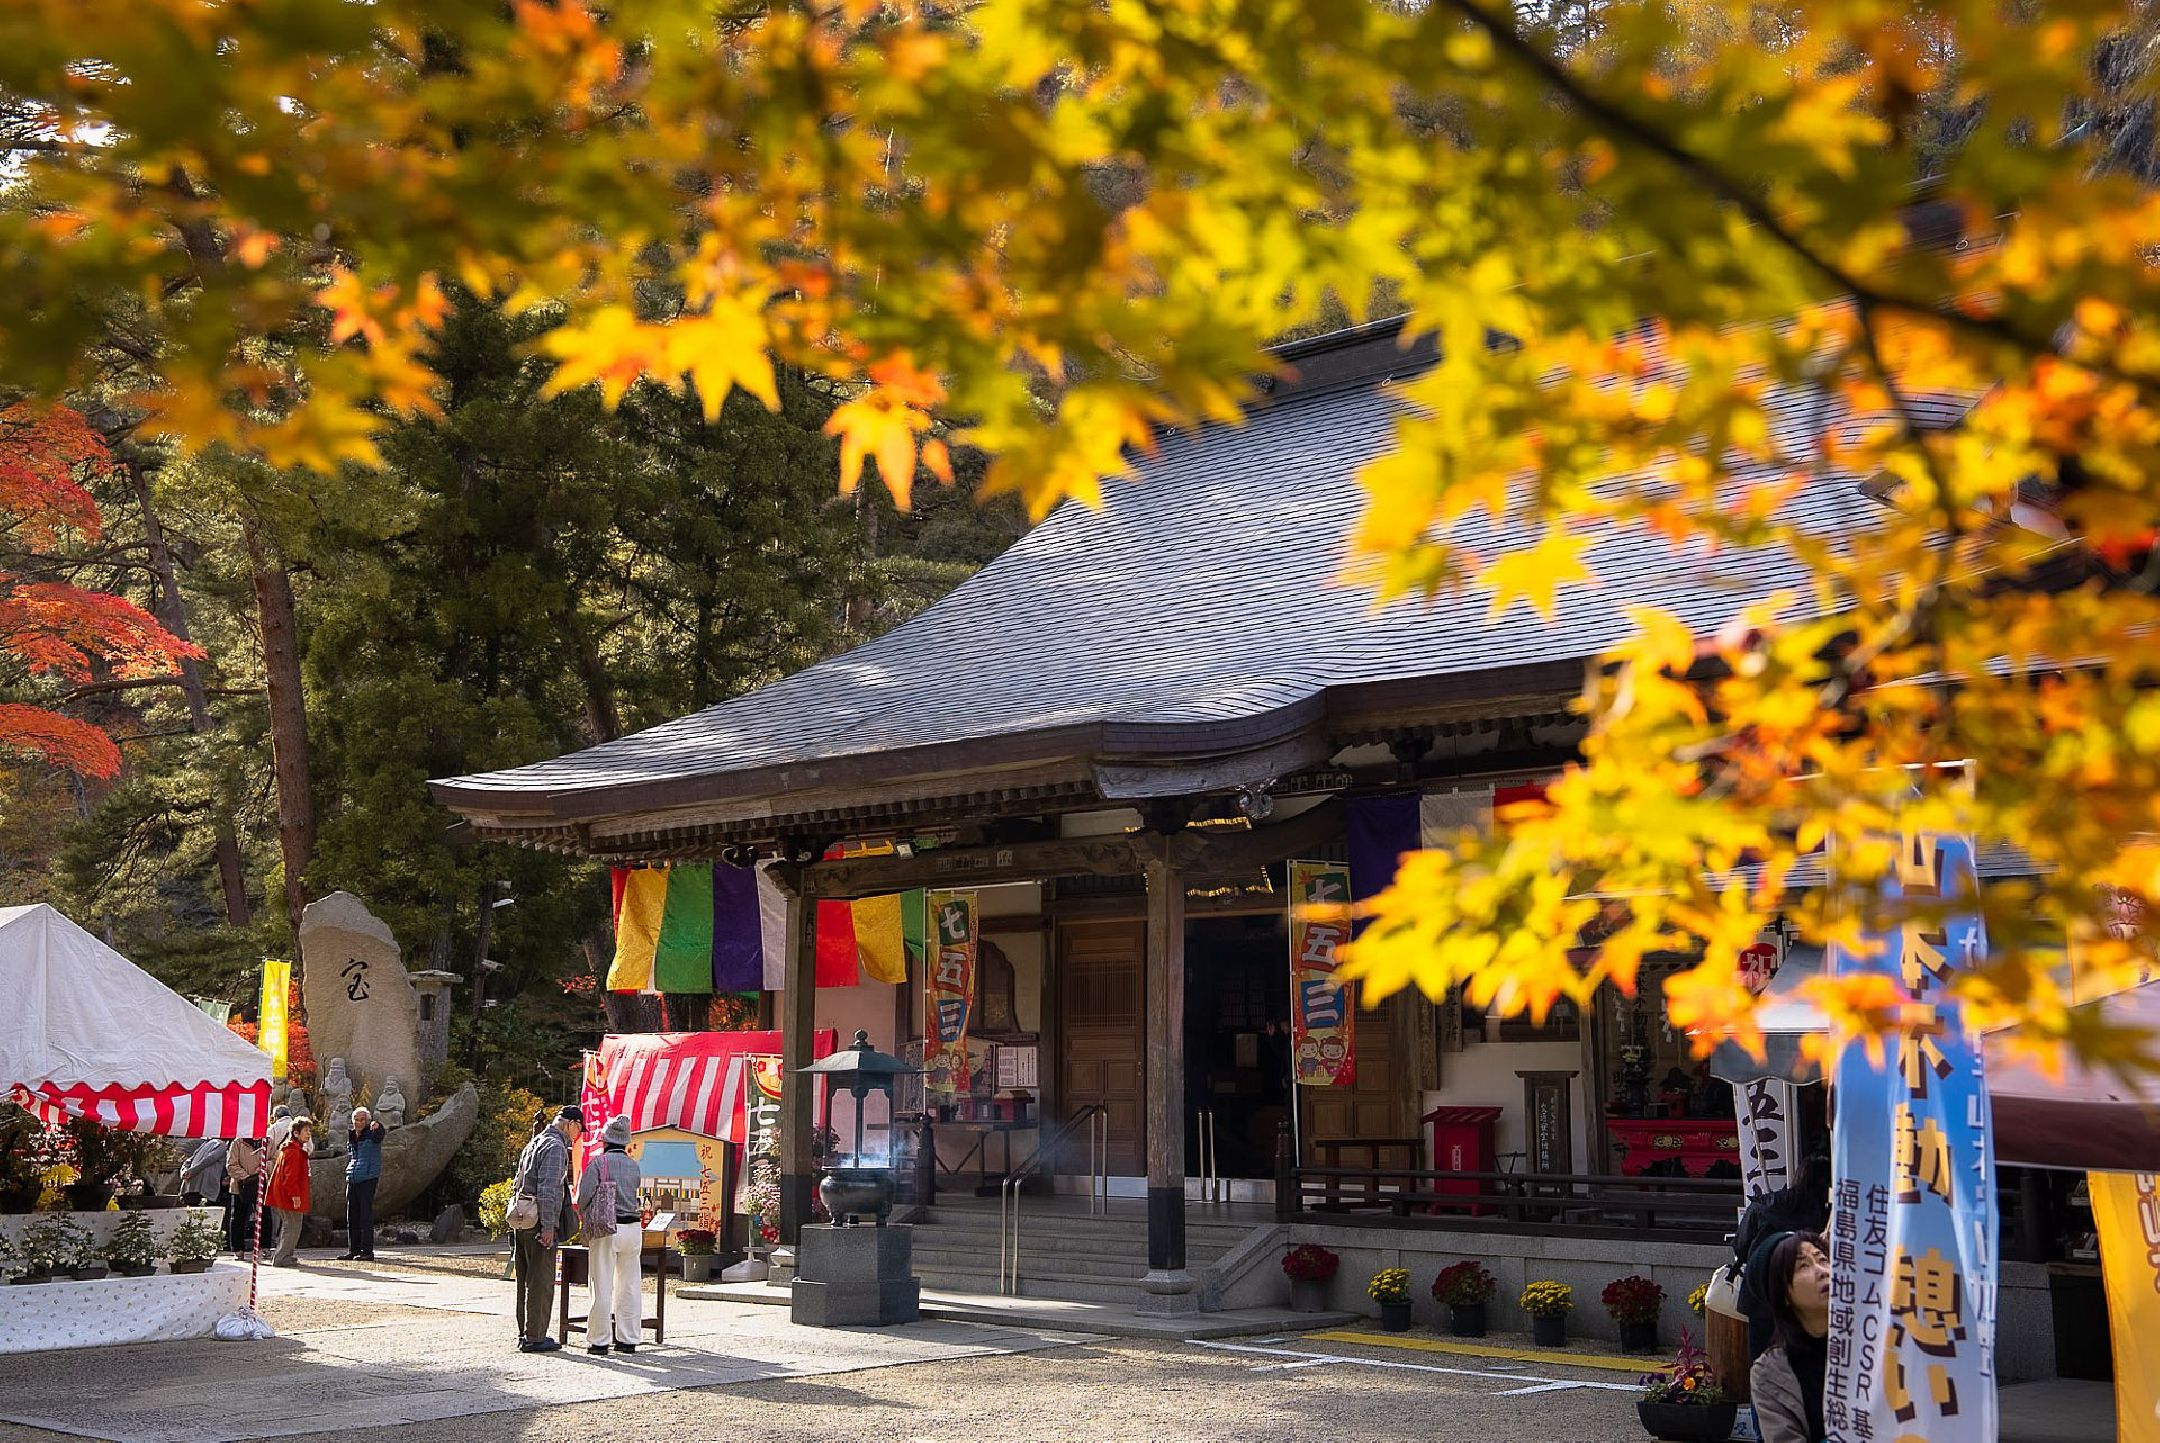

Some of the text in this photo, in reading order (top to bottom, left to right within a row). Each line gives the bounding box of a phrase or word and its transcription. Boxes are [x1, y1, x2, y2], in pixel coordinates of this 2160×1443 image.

[341, 957, 370, 1001] 宝
[937, 906, 966, 1036] 七五三
